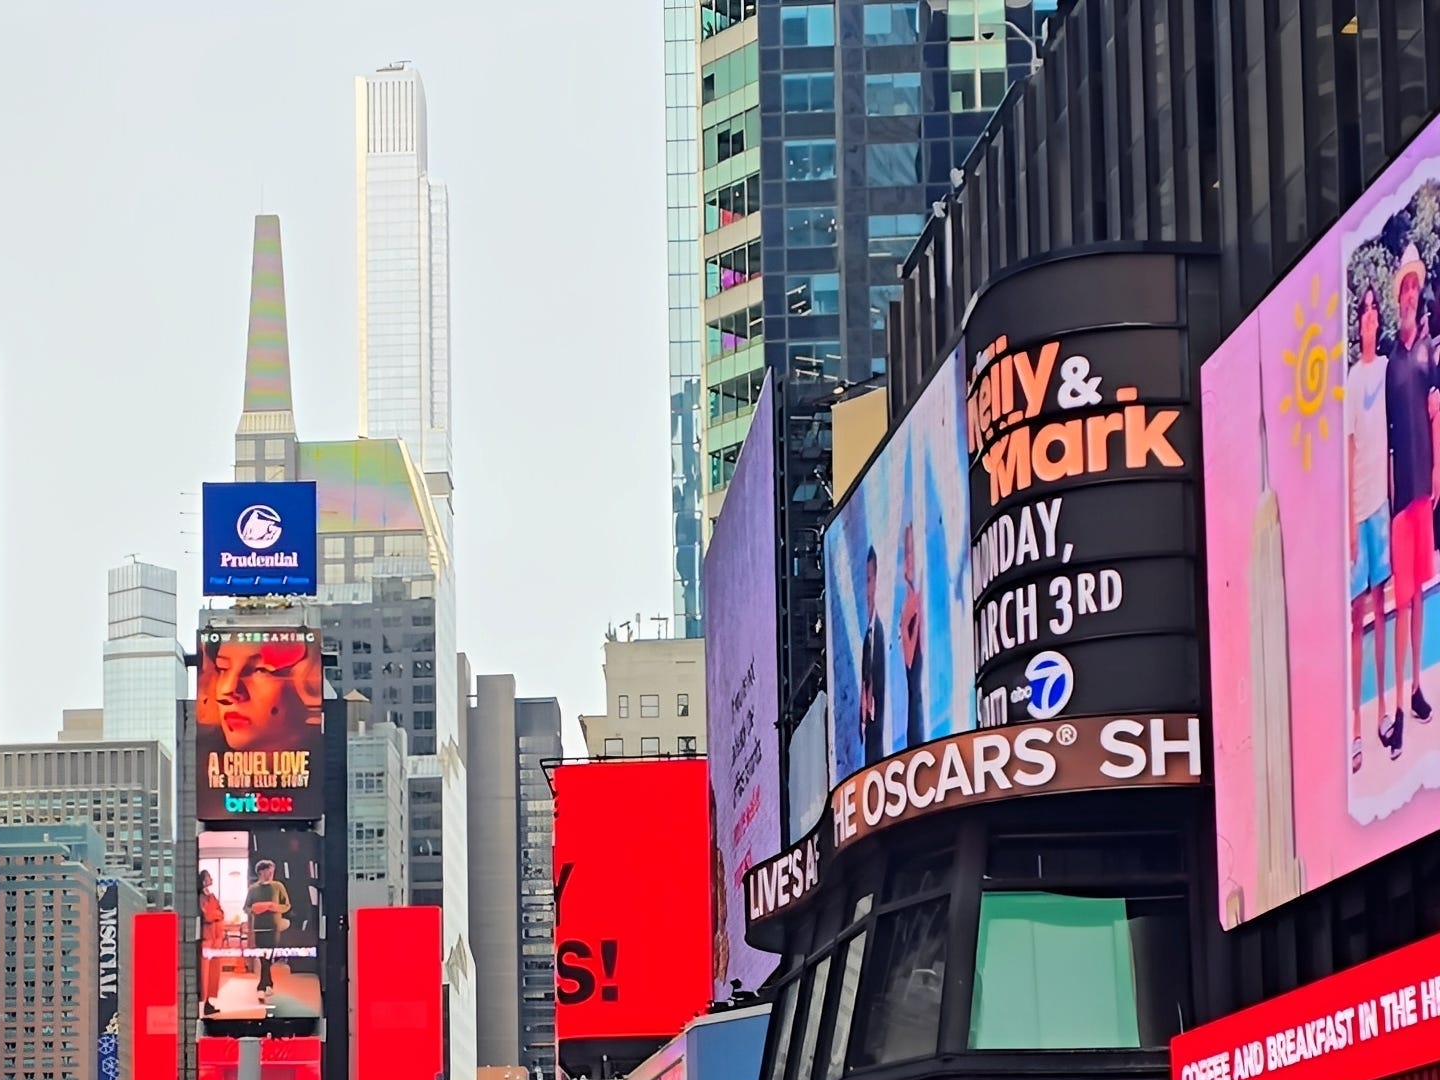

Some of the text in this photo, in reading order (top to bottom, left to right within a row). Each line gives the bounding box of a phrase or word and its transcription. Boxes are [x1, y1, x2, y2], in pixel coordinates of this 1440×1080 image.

[1057, 355, 1103, 409] &
[982, 387, 1185, 506] Mark
[220, 551, 299, 568] Prudential
[200, 632, 315, 642] NOW STREAMING
[974, 569, 1123, 673] ARCH 3RD
[208, 751, 310, 776] A CRUEL LOVE
[831, 786, 858, 849] HE
[1099, 717, 1202, 780] SH
[224, 792, 293, 813] britbox
[1266, 1007, 1355, 1072] BREAKFAST
[1358, 999, 1379, 1042] IN
[1380, 985, 1418, 1033] THE
